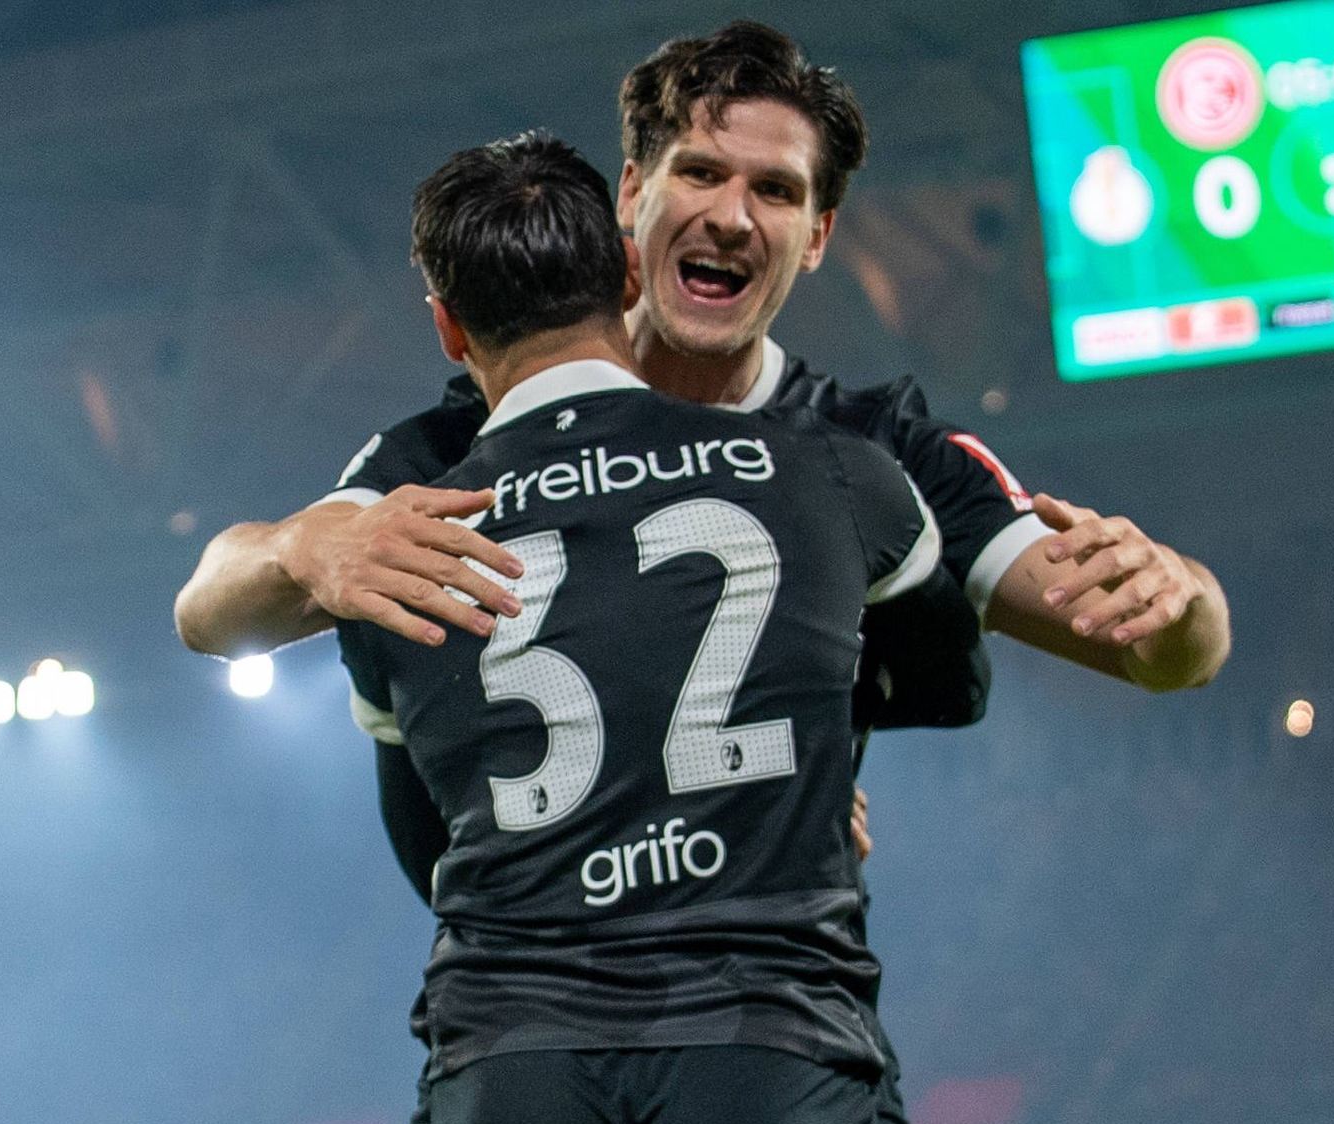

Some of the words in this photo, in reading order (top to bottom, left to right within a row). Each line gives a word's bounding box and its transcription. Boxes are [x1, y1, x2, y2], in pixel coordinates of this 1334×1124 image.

[1192, 154, 1262, 240] 0
[492, 438, 776, 520] freiburg
[443, 497, 797, 832] 32
[579, 817, 727, 907] grifo
